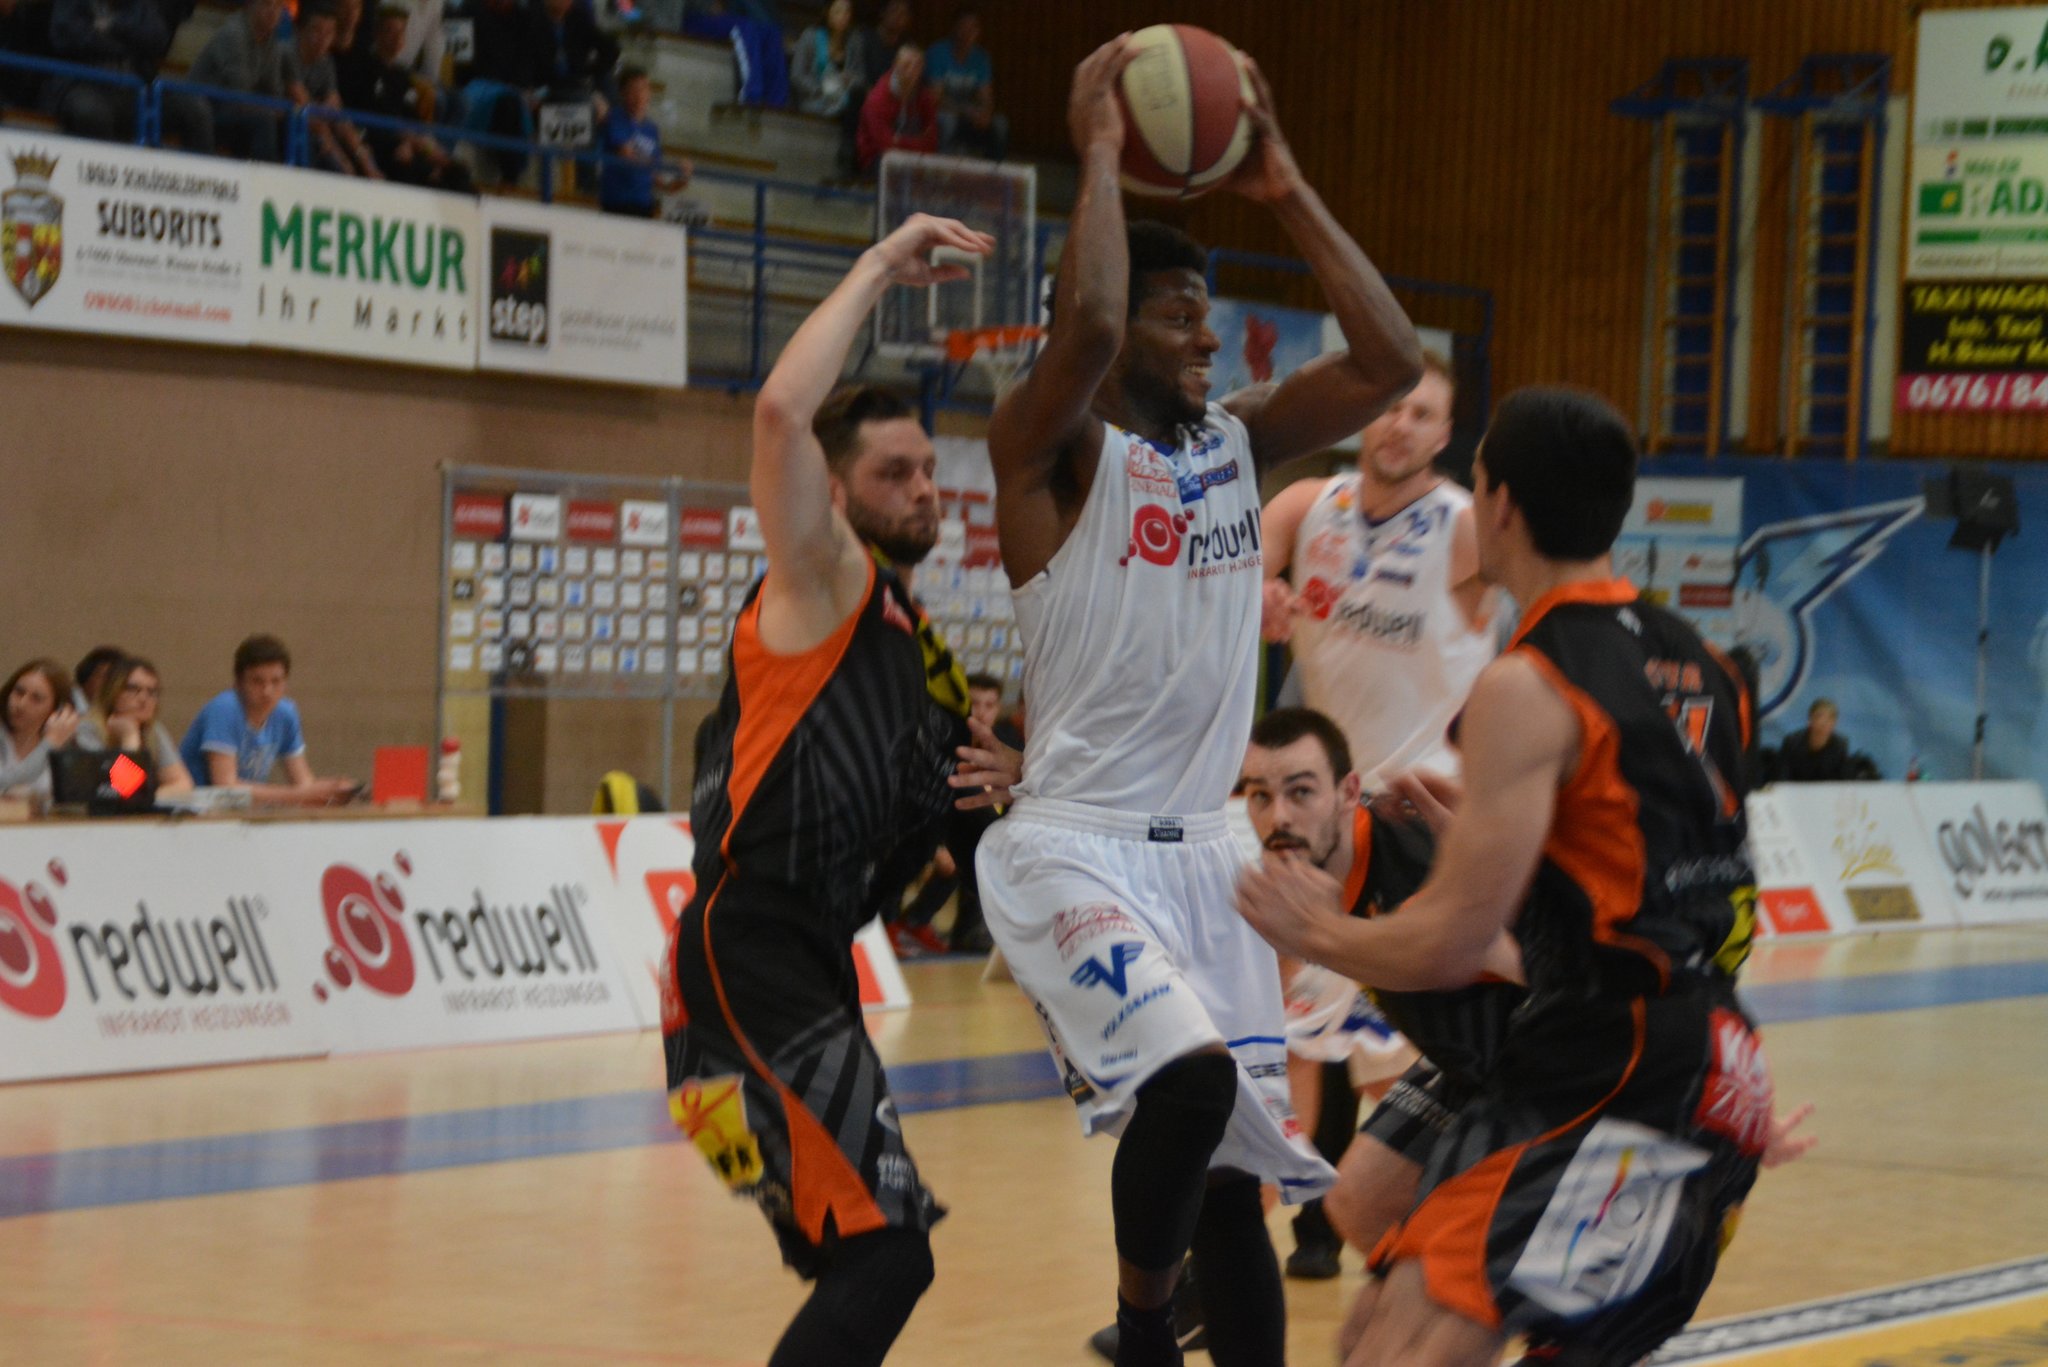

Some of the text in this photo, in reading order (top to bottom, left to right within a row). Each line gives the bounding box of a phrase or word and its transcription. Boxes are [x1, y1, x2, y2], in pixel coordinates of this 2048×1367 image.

[544, 121, 588, 143] VIP
[97, 200, 222, 248] SUBORITS
[260, 198, 467, 294] MERKUR
[258, 283, 321, 323] Ihr
[353, 296, 468, 341] Markt
[492, 294, 546, 345] step
[68, 895, 278, 1003] redwell
[414, 882, 598, 983] redwell
